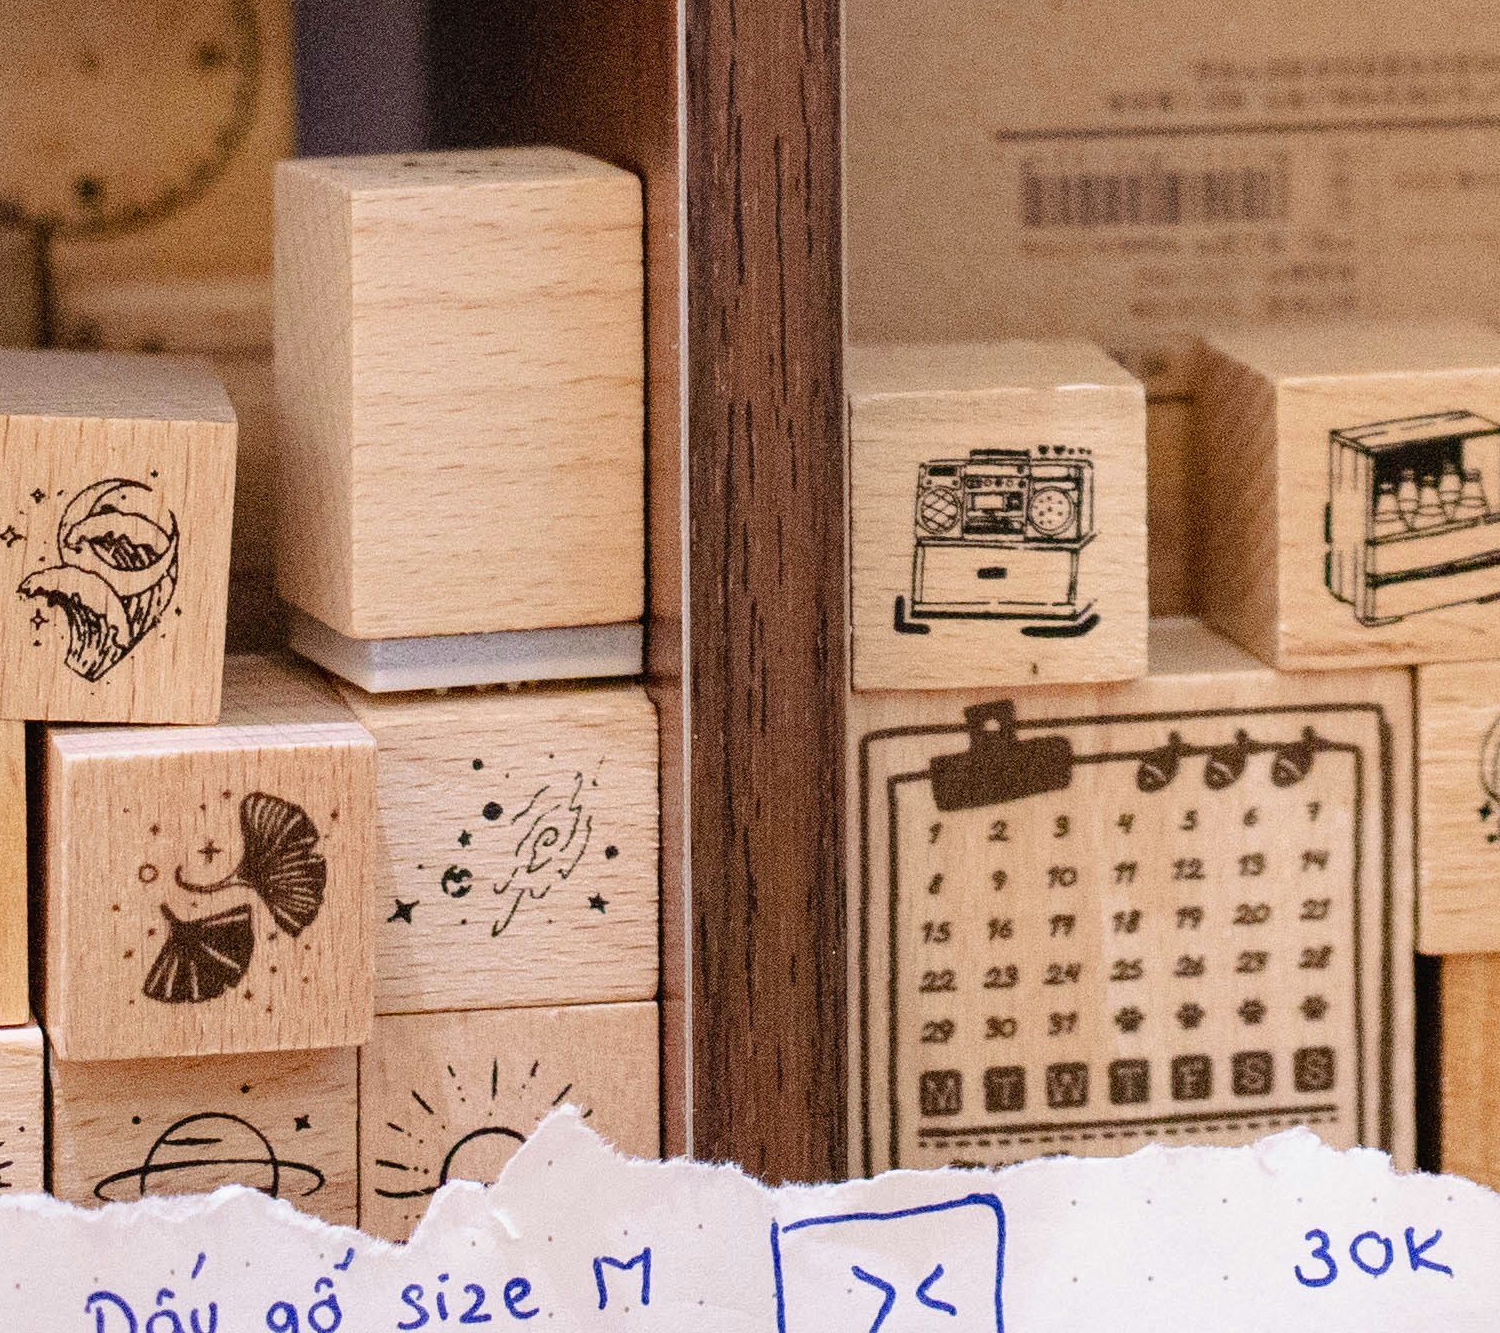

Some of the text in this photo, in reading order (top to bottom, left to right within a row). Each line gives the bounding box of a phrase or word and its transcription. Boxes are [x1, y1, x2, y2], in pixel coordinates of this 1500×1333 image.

[928, 800, 1322, 844] 1 2 3 4 5 6 7
[928, 850, 1330, 895] 8 9 10 11 12 13 14
[921, 898, 1332, 944] 15 16 17 18 19 20 21
[918, 945, 1334, 994] 22 23 24 25 26 27 28
[920, 1011, 1079, 1044] 29 30 31
[398, 1273, 540, 1330] size
[592, 1247, 653, 1310] M
[1295, 1227, 1453, 1287] 30K
